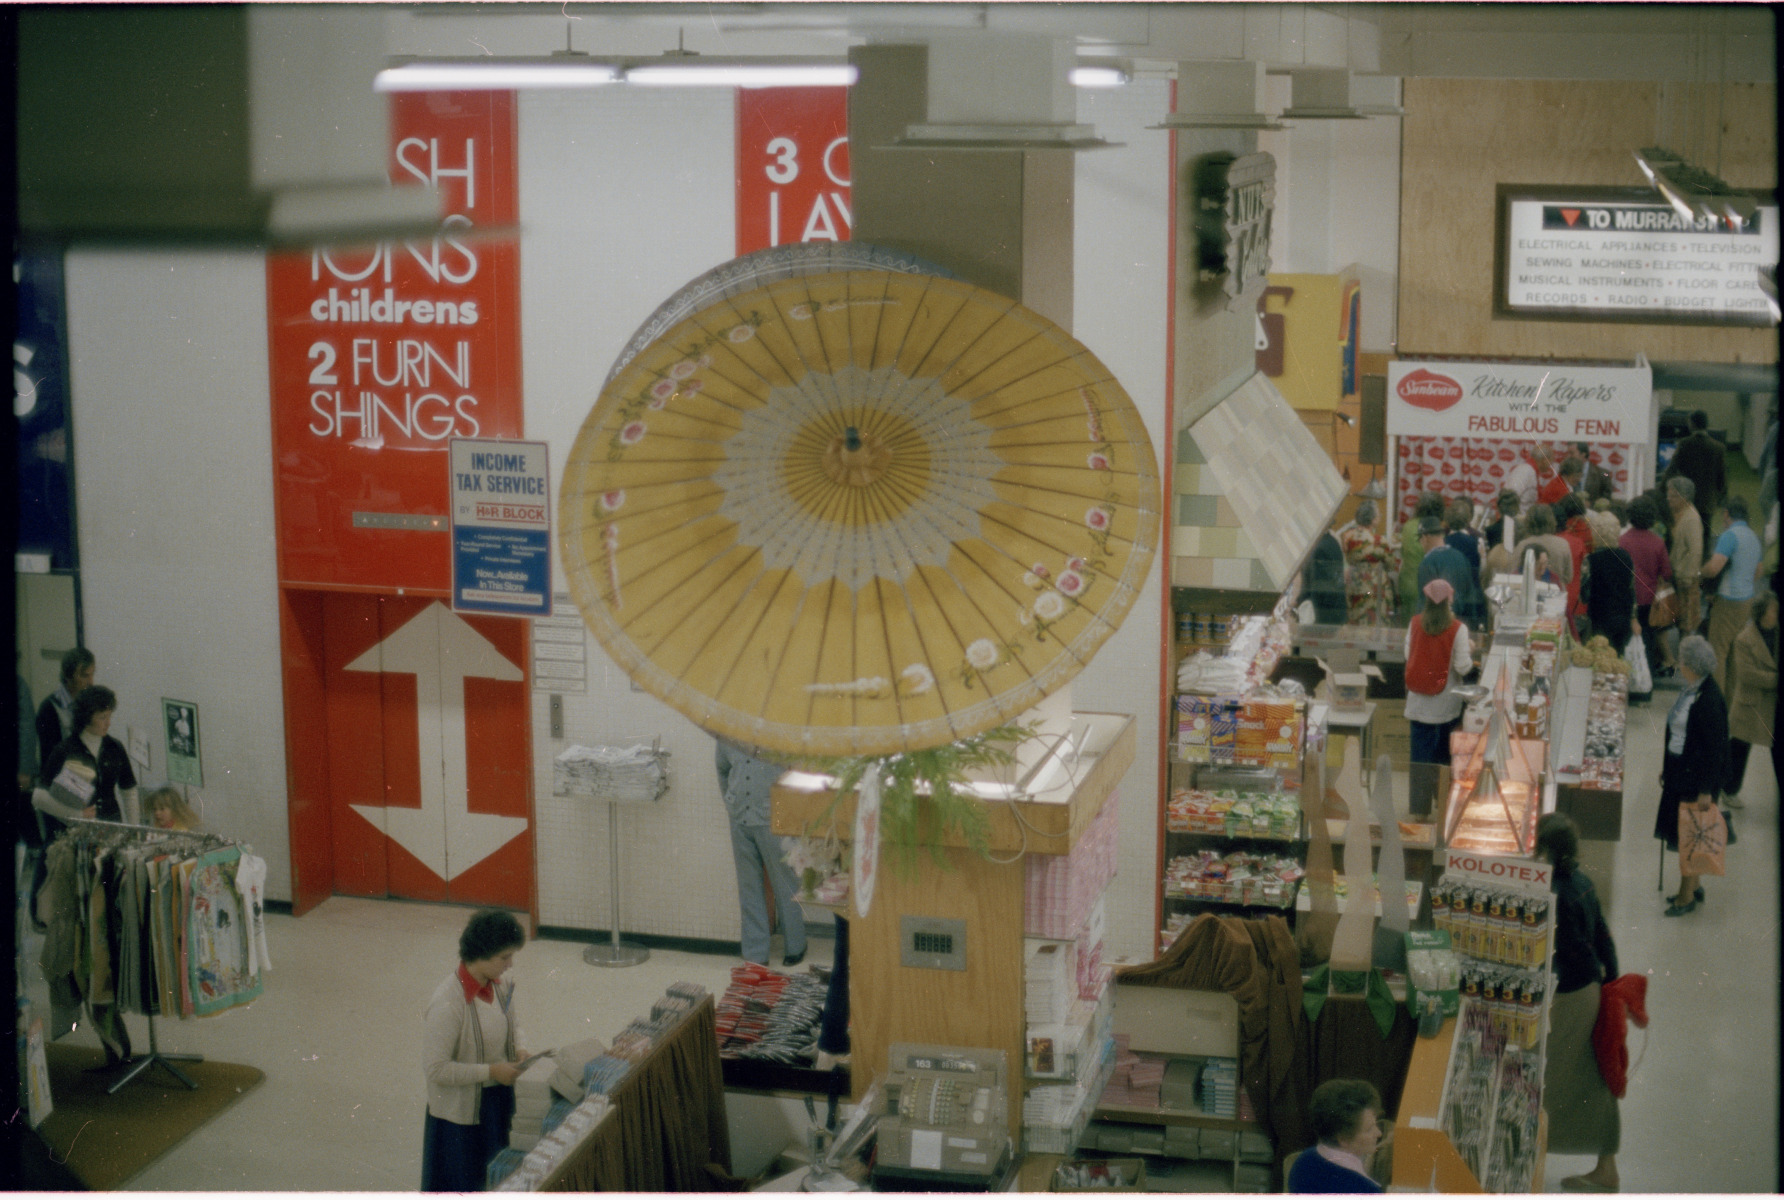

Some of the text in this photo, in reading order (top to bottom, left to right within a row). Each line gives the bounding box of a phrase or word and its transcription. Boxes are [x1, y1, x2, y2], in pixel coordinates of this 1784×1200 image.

[765, 137, 799, 185] 3
[1586, 209, 1611, 228] TO
[1518, 239, 1762, 254] ELECTRICAL APPLIANCES TELEVISION
[1526, 257, 1573, 268] SEWING
[1581, 259, 1642, 270] MACHINES
[1653, 260, 1723, 272] ELECTRICAL
[1518, 275, 1572, 286] MUSICAL
[1579, 276, 1664, 288] INSTRUMENTS
[1678, 279, 1718, 290] FLOOR
[310, 288, 479, 325] childrens
[1526, 292, 1587, 303] RECORDS
[1608, 294, 1648, 305] RADIO
[1664, 296, 1716, 307] BUDGET
[308, 338, 470, 389] 2 FURNI
[1400, 380, 1460, 398] Sunbeam
[1470, 374, 1536, 400] Kitchen
[308, 390, 480, 441] SHINGS
[1509, 402, 1567, 414] WITH THE
[1468, 415, 1621, 436] FABULOUS FENN
[471, 452, 526, 473] INCOME
[457, 473, 545, 495] TAX SERVICE
[459, 505, 546, 521] BY H&R BLOCK
[1448, 855, 1548, 884] KOLOTEX
[915, 1059, 931, 1069] 163
